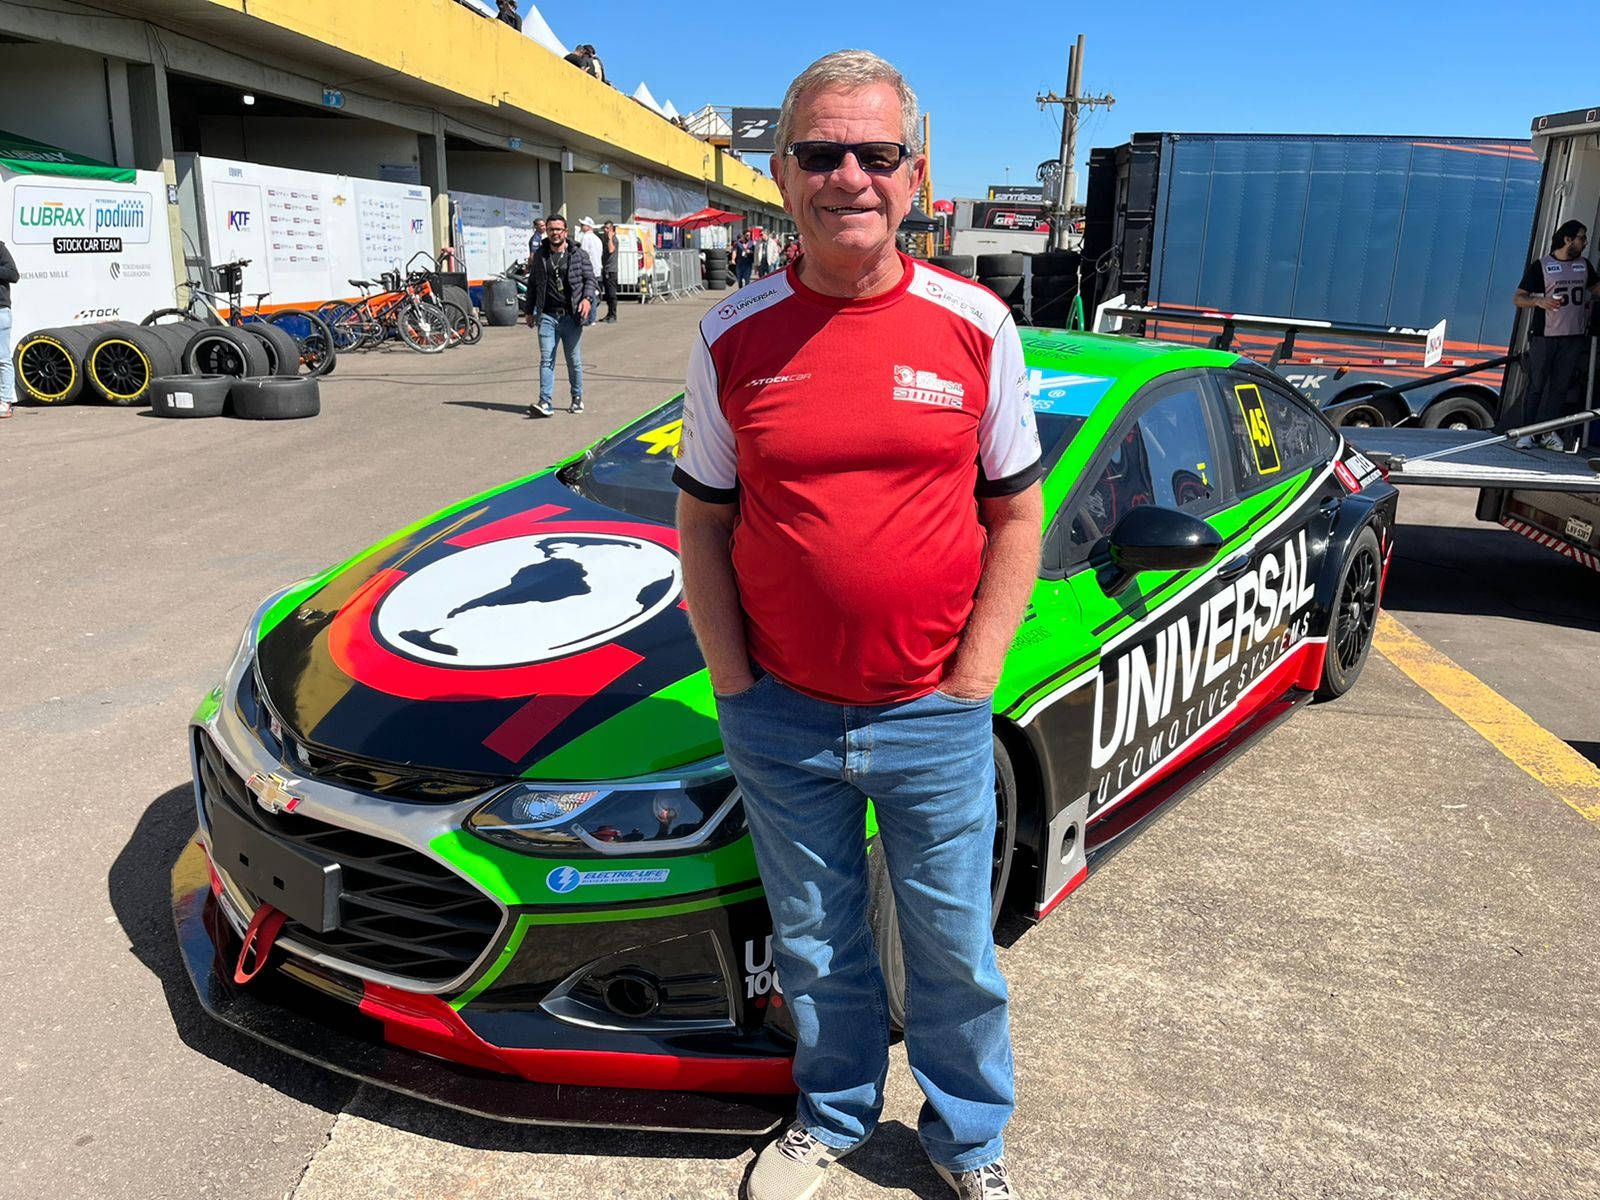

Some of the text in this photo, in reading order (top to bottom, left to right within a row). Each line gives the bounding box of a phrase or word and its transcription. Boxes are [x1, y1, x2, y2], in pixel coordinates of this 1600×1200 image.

[20, 206, 86, 227] LUBRAX
[95, 203, 144, 232] podium
[227, 210, 250, 231] KTF
[56, 238, 120, 252] STOCK CAR TEAM
[736, 289, 777, 310] UNIVERSAL
[636, 418, 685, 459] 4
[1249, 408, 1270, 447] 45
[1091, 529, 1316, 769] UNIVERSAL
[1097, 612, 1311, 804] UTOMOTIVE SYSTEMS
[744, 934, 776, 974] U
